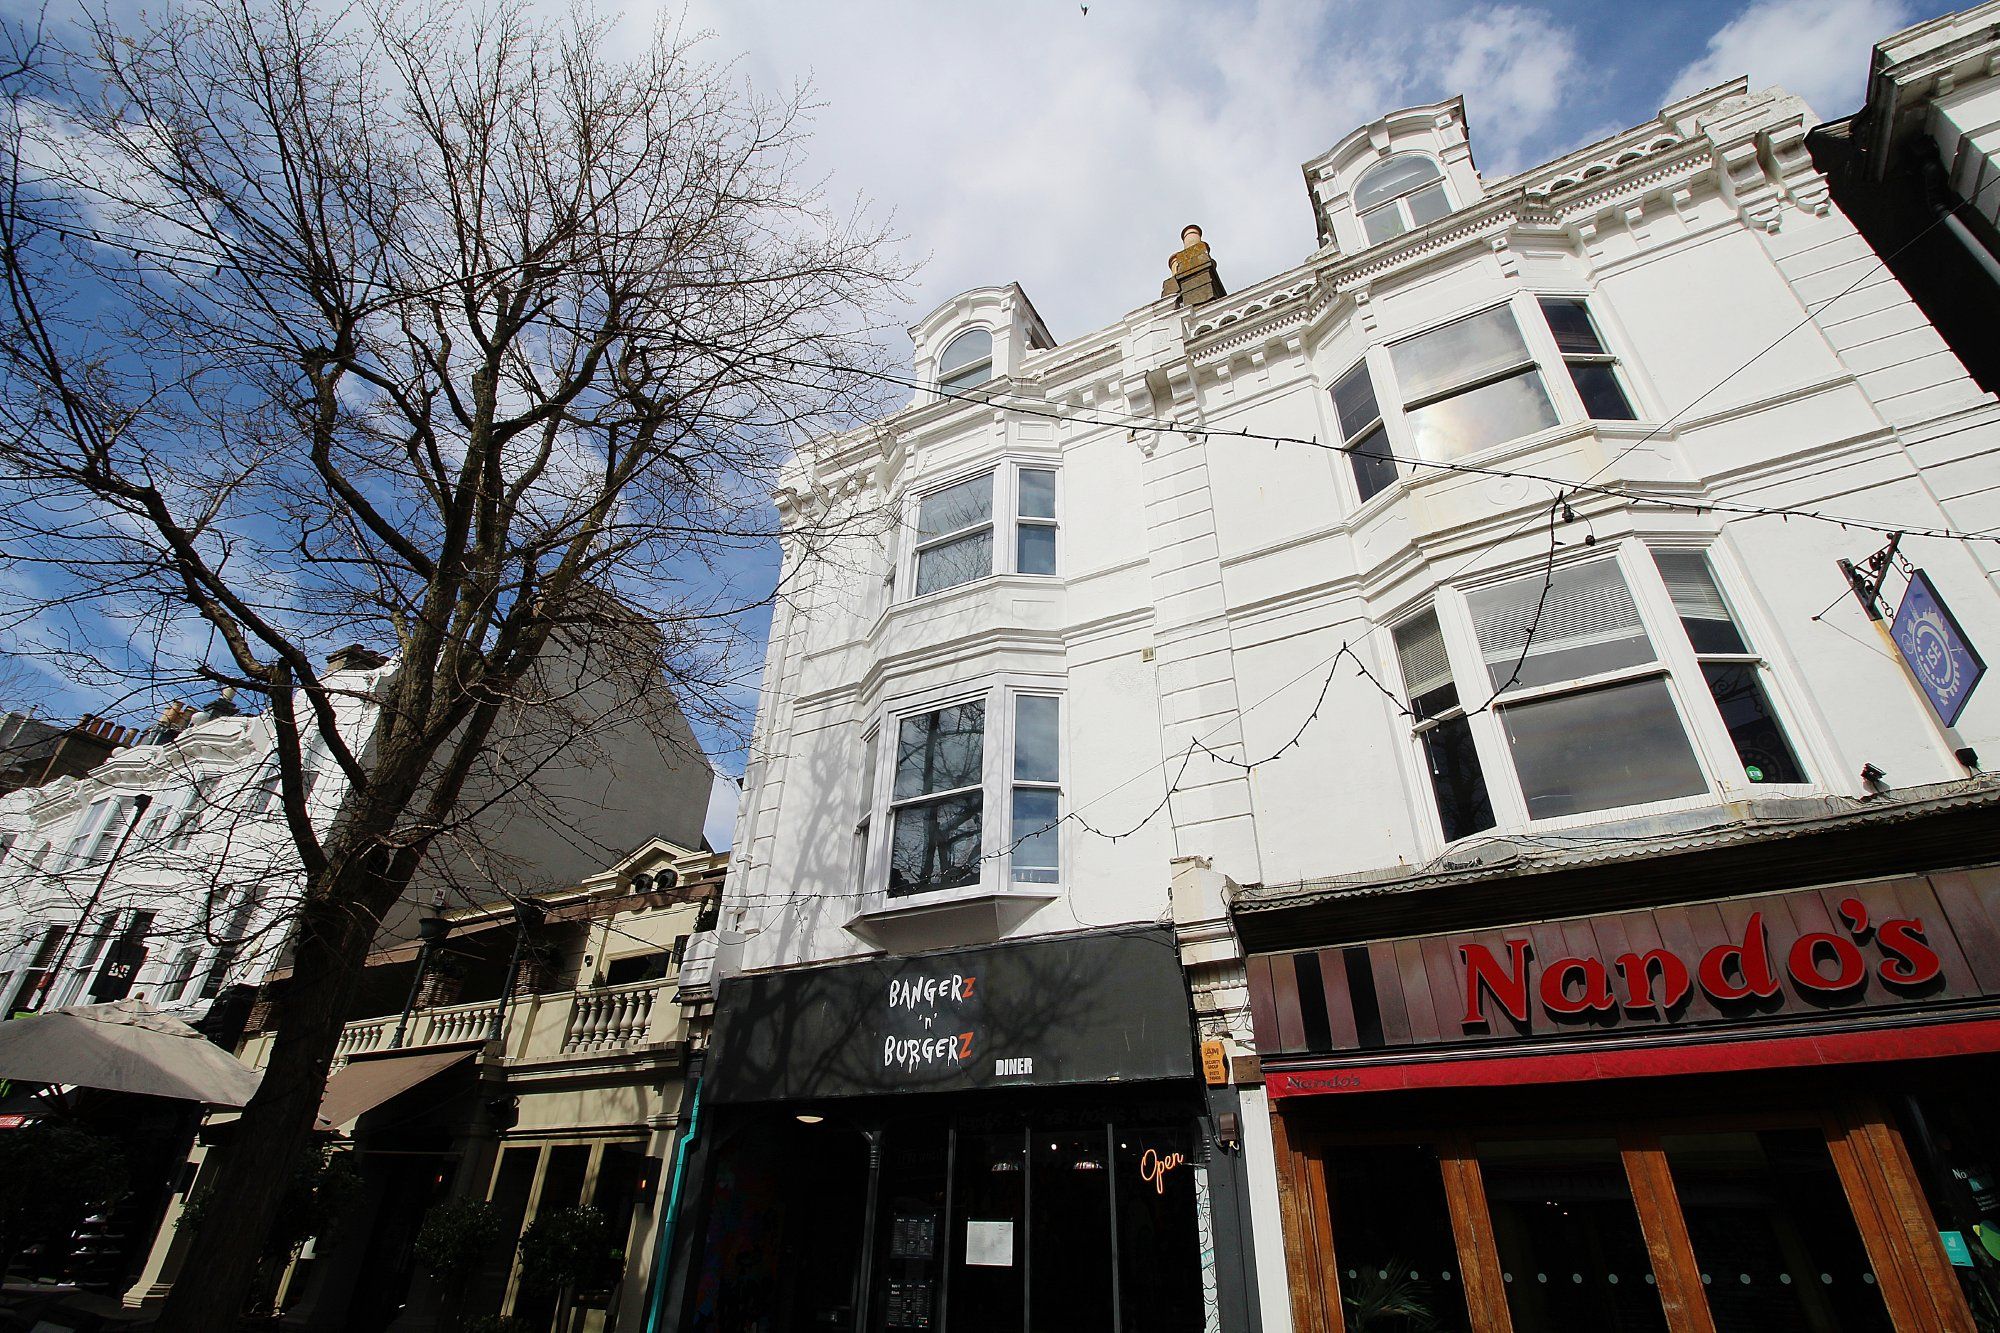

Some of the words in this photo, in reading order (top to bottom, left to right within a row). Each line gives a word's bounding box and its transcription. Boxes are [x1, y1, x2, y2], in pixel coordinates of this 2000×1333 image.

[1925, 640, 1942, 669] ISE
[1459, 898, 1941, 1023] Nando's
[889, 974, 976, 1012] BANGERZ
[884, 1031, 974, 1073] BURGERZ
[995, 1057, 1034, 1076] DINER
[1140, 1148, 1184, 1194] Open
